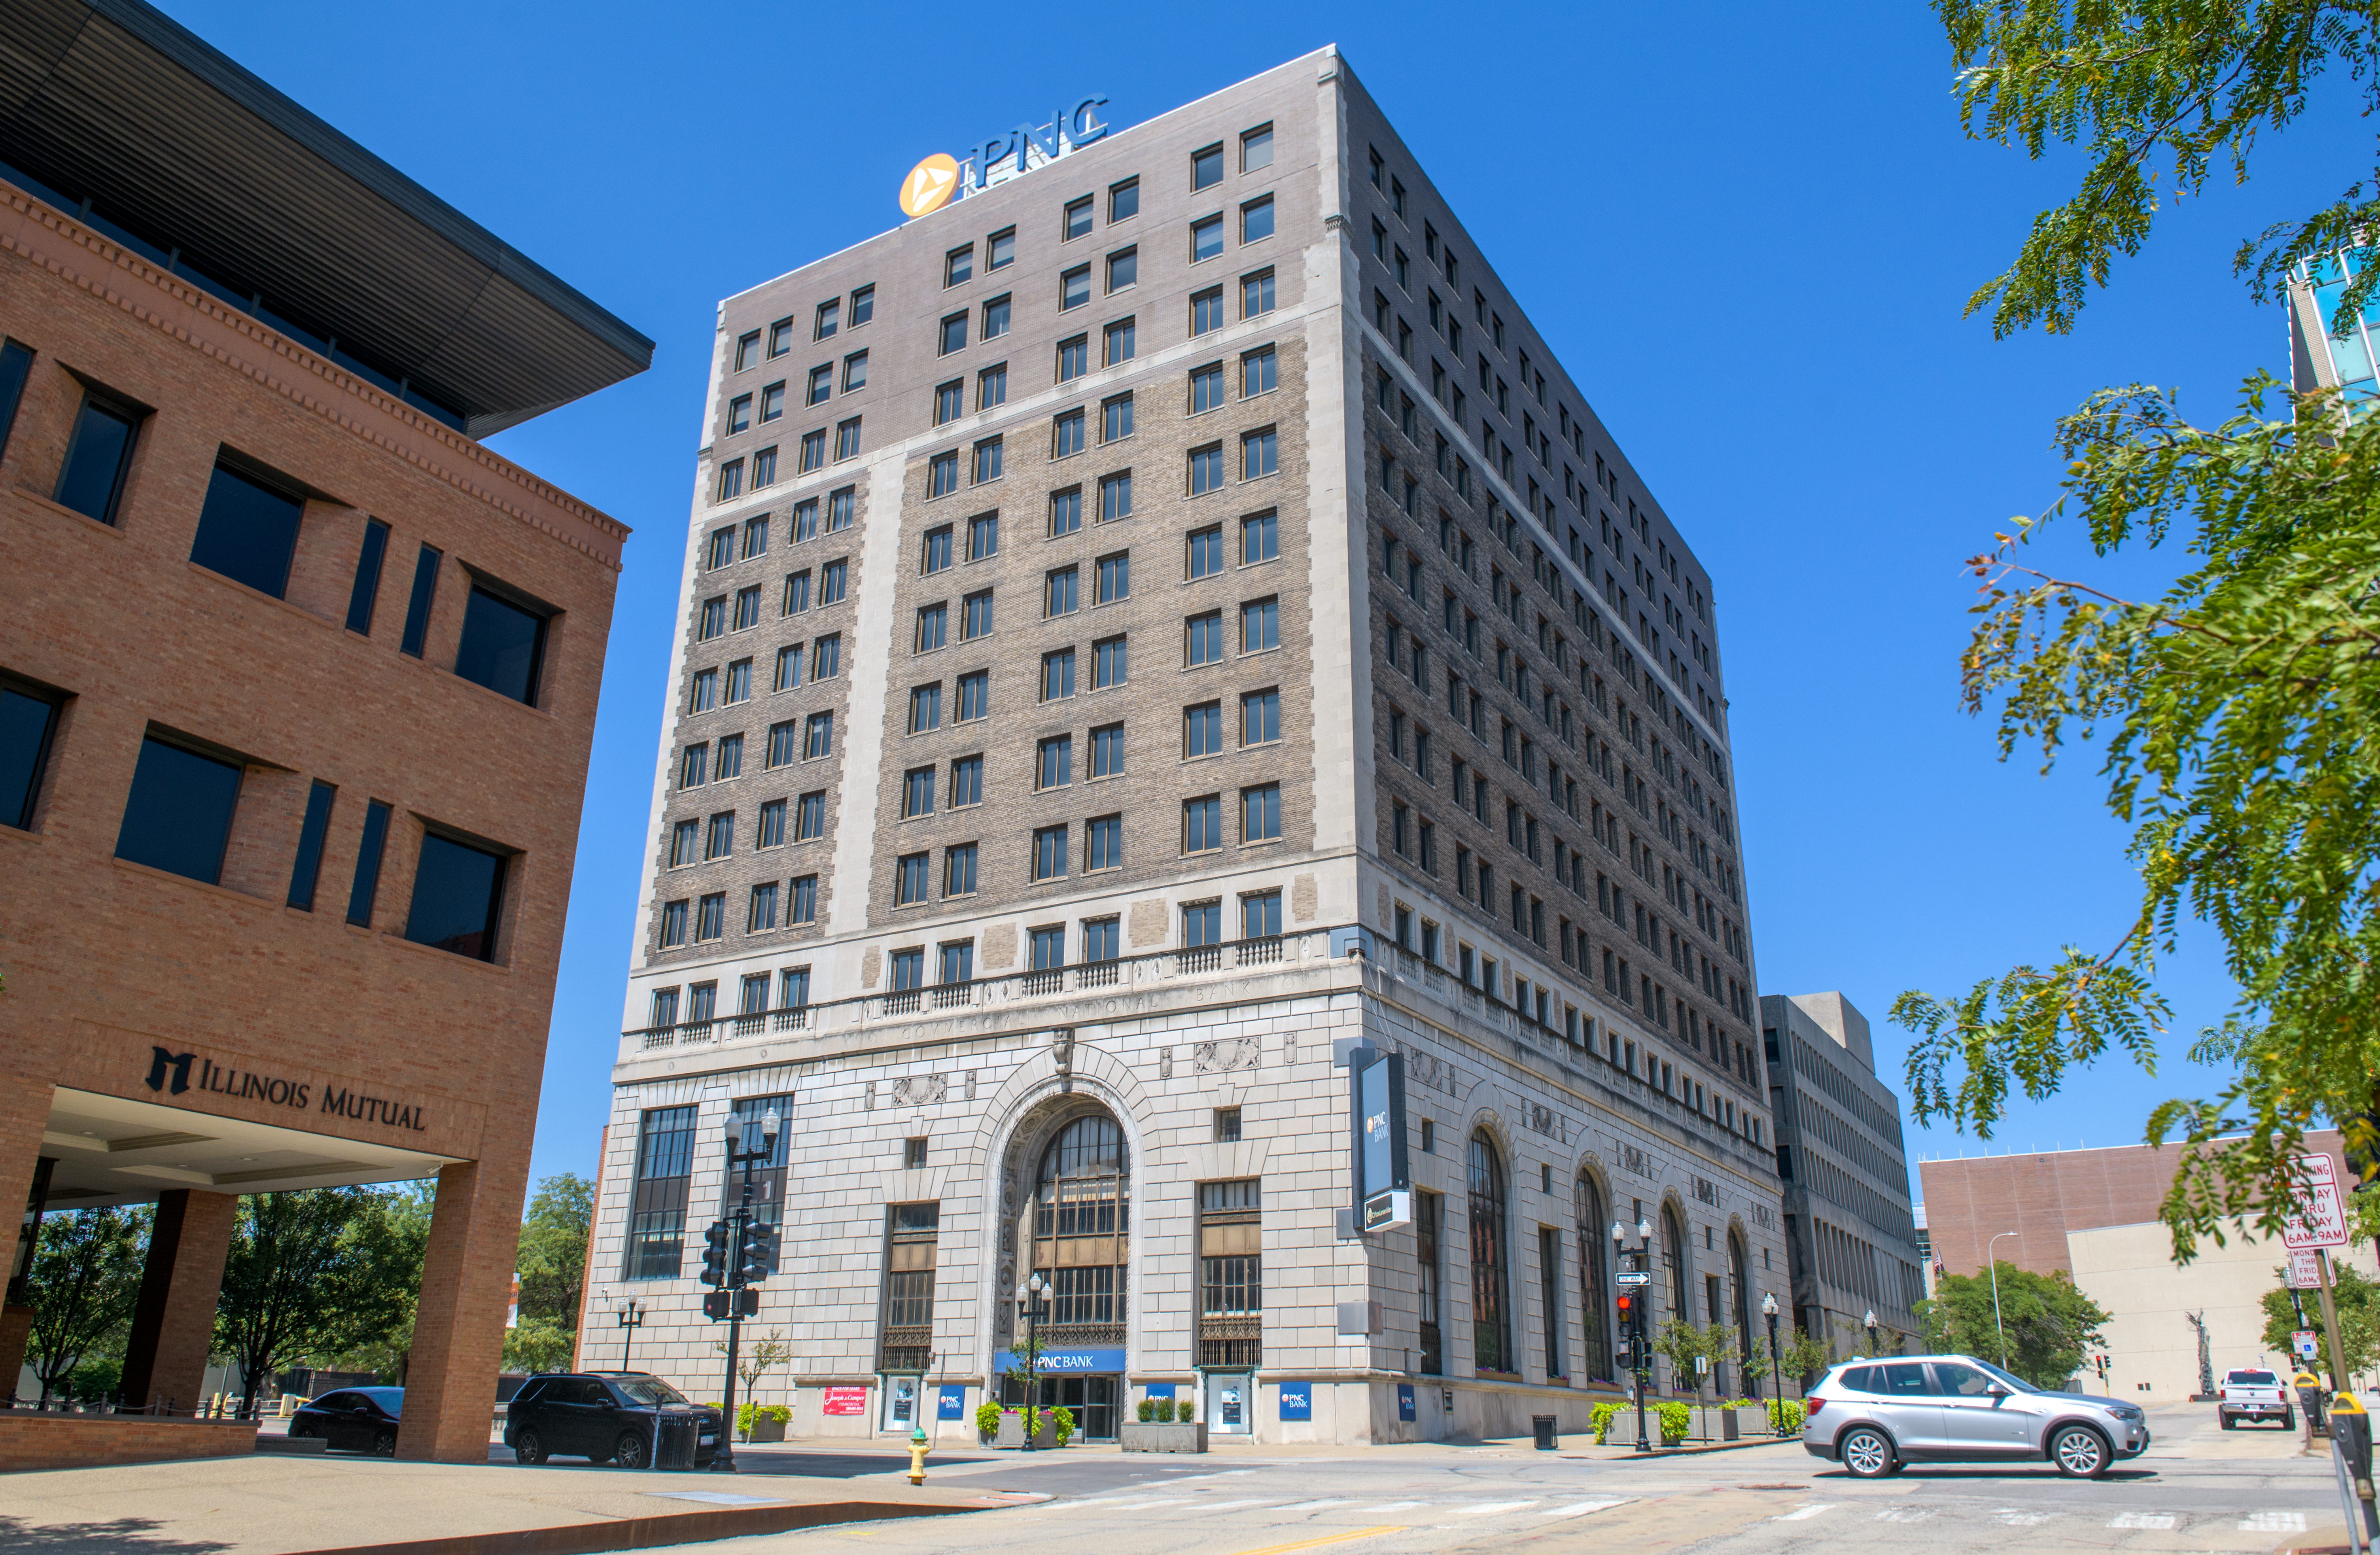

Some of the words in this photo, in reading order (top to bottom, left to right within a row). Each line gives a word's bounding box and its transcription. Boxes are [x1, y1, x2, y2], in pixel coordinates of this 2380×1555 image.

[971, 92, 1109, 188] PNC
[902, 1013, 1024, 1039] COMMERCIAL
[1059, 995, 1158, 1018] NATIONAL
[1196, 982, 1251, 1001] BANK
[1373, 1111, 1385, 1129] PNC
[1374, 1123, 1389, 1142] BANK
[2289, 1216, 2332, 1229] FRDAY
[1038, 1356, 1061, 1368] PNC
[1062, 1356, 1094, 1368] BANK
[825, 1392, 844, 1405] Joseph
